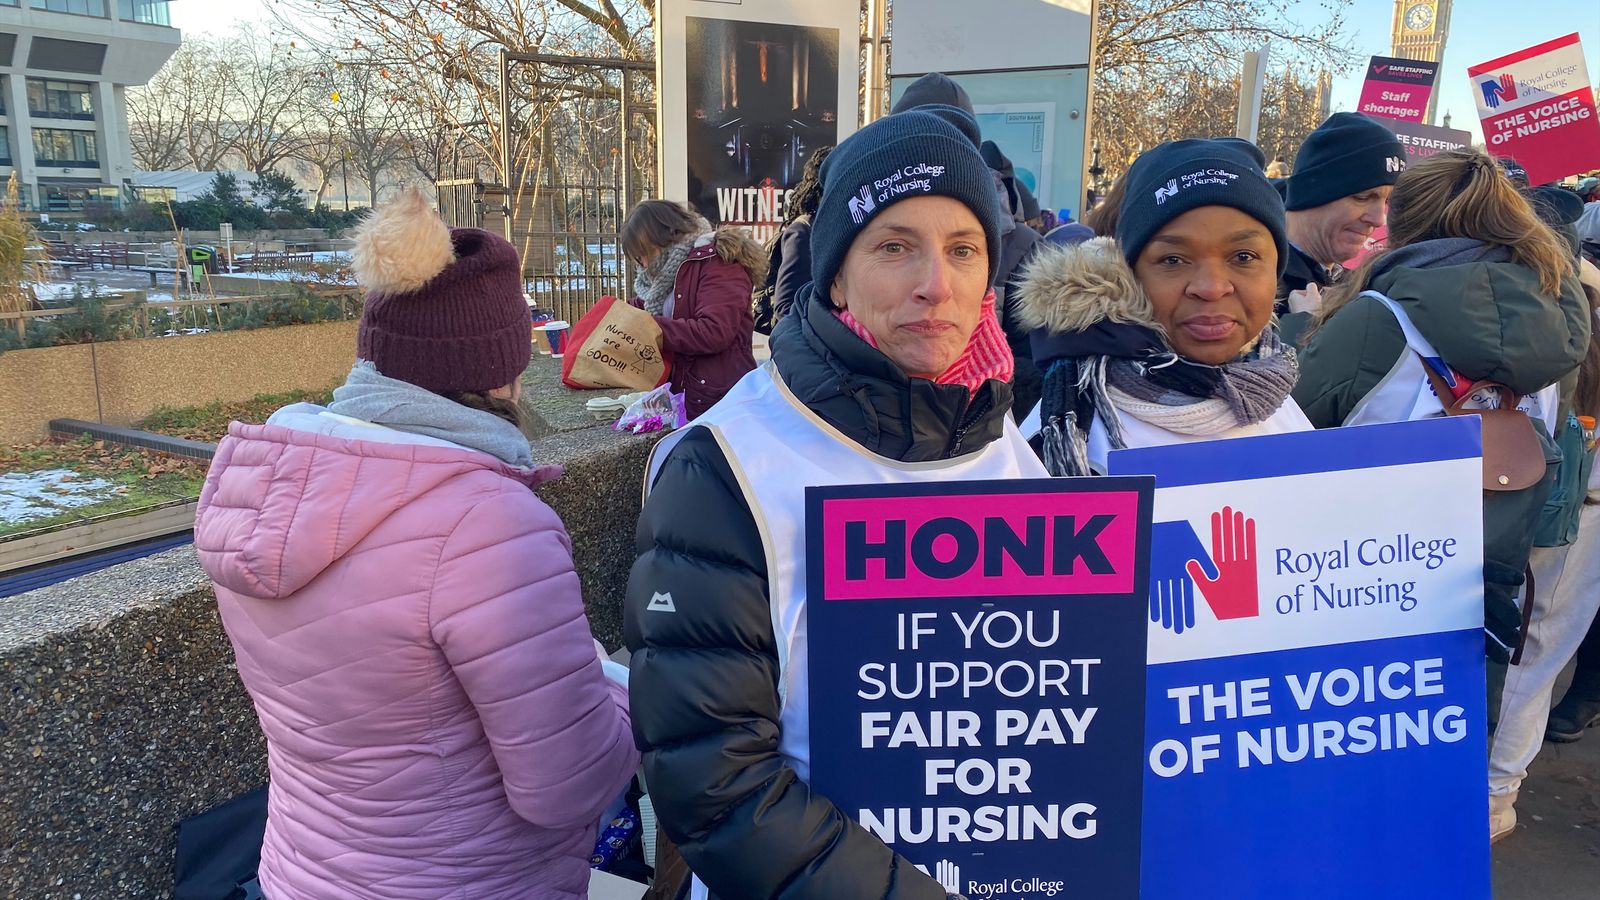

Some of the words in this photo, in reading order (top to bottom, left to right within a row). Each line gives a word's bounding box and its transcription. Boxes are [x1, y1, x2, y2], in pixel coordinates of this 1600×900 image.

[1405, 66, 1433, 75] STAFFING
[1520, 73, 1544, 89] Royal
[1545, 63, 1578, 80] College
[1381, 90, 1411, 102] Staff
[1522, 86, 1533, 98] of
[1533, 77, 1568, 94] Nursing
[1363, 103, 1420, 117] shortages
[1494, 113, 1527, 131] THE
[1528, 96, 1581, 120] VOICE
[1491, 130, 1514, 145] OF
[1517, 107, 1591, 139] NURSING
[873, 168, 903, 190] Royal
[903, 163, 945, 177] College
[1180, 168, 1205, 182] Royal
[1206, 168, 1239, 180] College
[1182, 180, 1192, 189] of
[1193, 176, 1228, 186] Nursing
[878, 189, 890, 202] of
[890, 178, 932, 197] Nursing
[603, 337, 621, 351] are
[605, 324, 636, 345] Nurses
[586, 348, 628, 373] GOOD!!!
[845, 514, 1119, 581] HONK
[1275, 540, 1350, 583] Royal
[1357, 533, 1457, 570] College
[1275, 584, 1305, 615] of
[1312, 577, 1418, 612] Nursing
[898, 612, 938, 650] IF
[951, 609, 1060, 649] YOU
[857, 658, 1101, 700] SUPPORT
[1167, 677, 1272, 725] THE
[1285, 657, 1444, 711] VOICE
[860, 710, 981, 749] FAIR
[995, 707, 1099, 746] PAY
[1149, 734, 1221, 778] OF
[1237, 705, 1467, 768] NURSING
[925, 757, 1032, 796] FOR
[858, 802, 1097, 844] NURSING
[968, 878, 1008, 900] Royal
[1011, 877, 1064, 897] College
